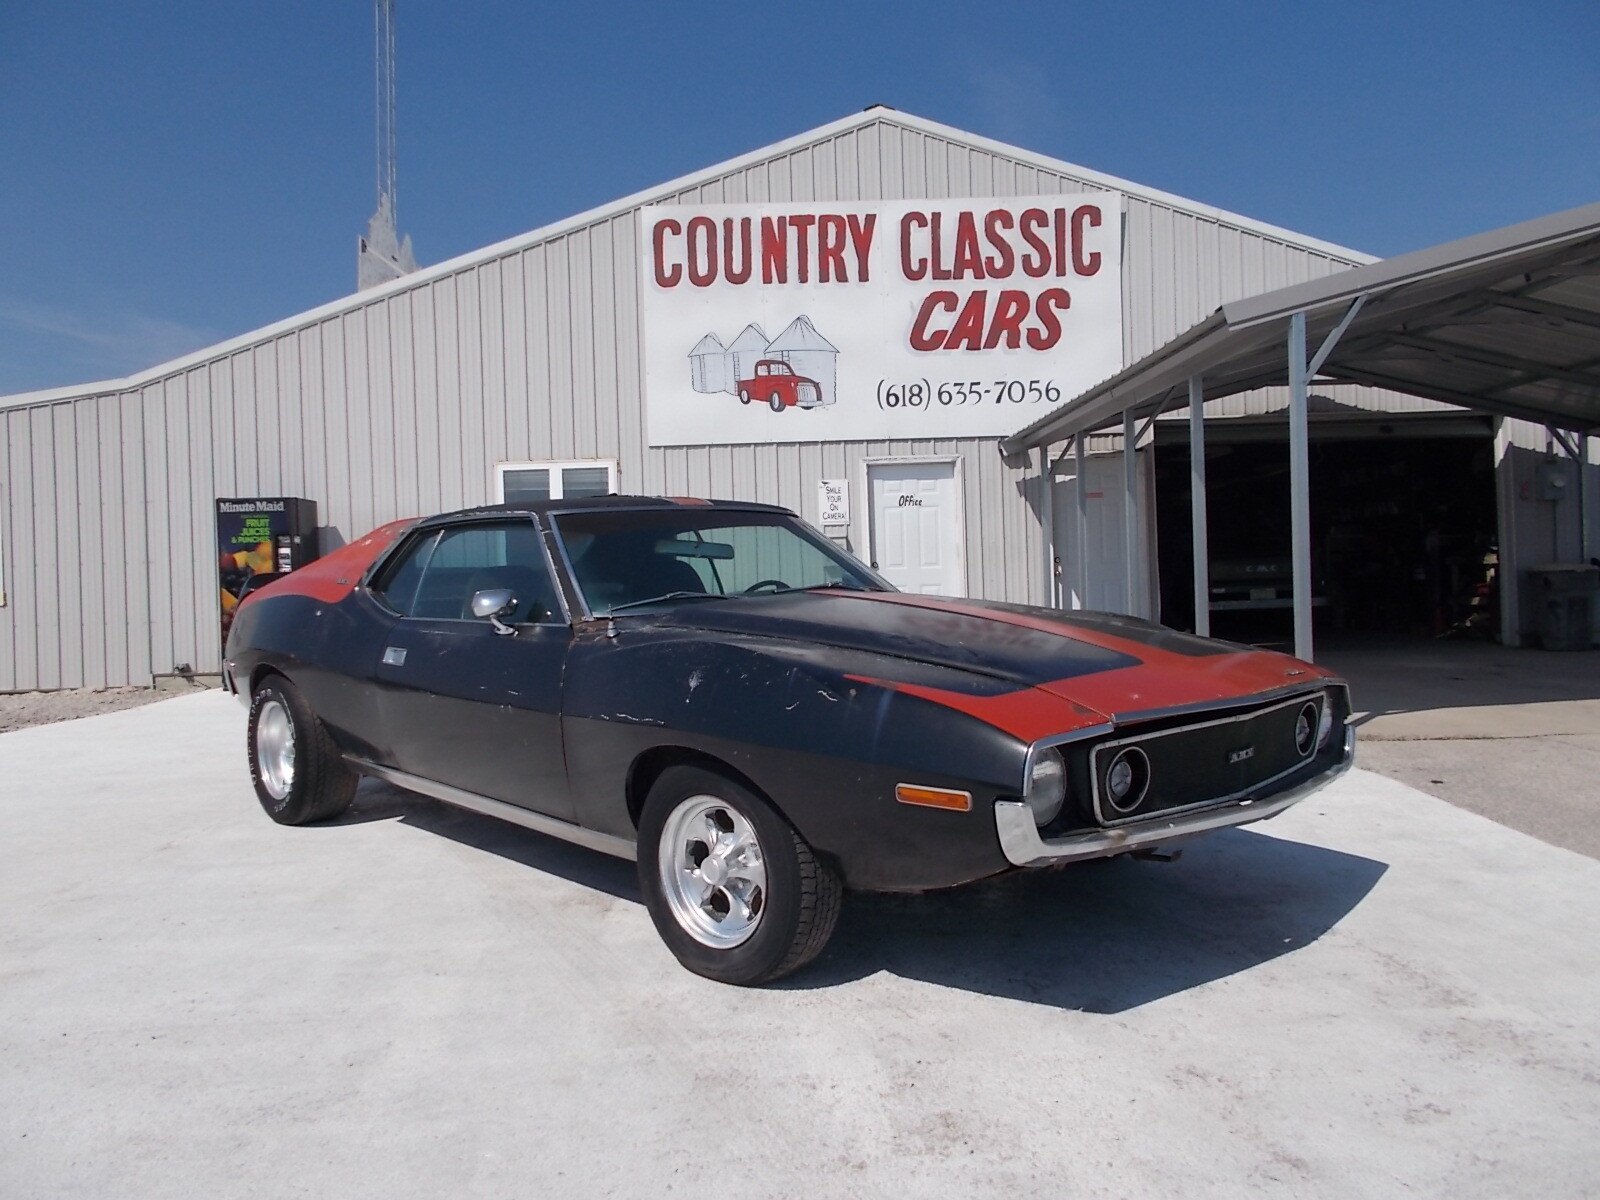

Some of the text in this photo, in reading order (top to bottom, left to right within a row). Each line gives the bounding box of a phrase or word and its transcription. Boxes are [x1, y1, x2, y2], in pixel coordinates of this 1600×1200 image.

[652, 204, 1103, 289] COUNTRY CLASSIC
[909, 287, 1072, 352] CARS
[876, 377, 1062, 412] (618) 635-7056
[825, 486, 842, 494] SMILE
[220, 501, 284, 512] Minute Maid
[829, 503, 839, 511] ON
[898, 494, 923, 507] Office
